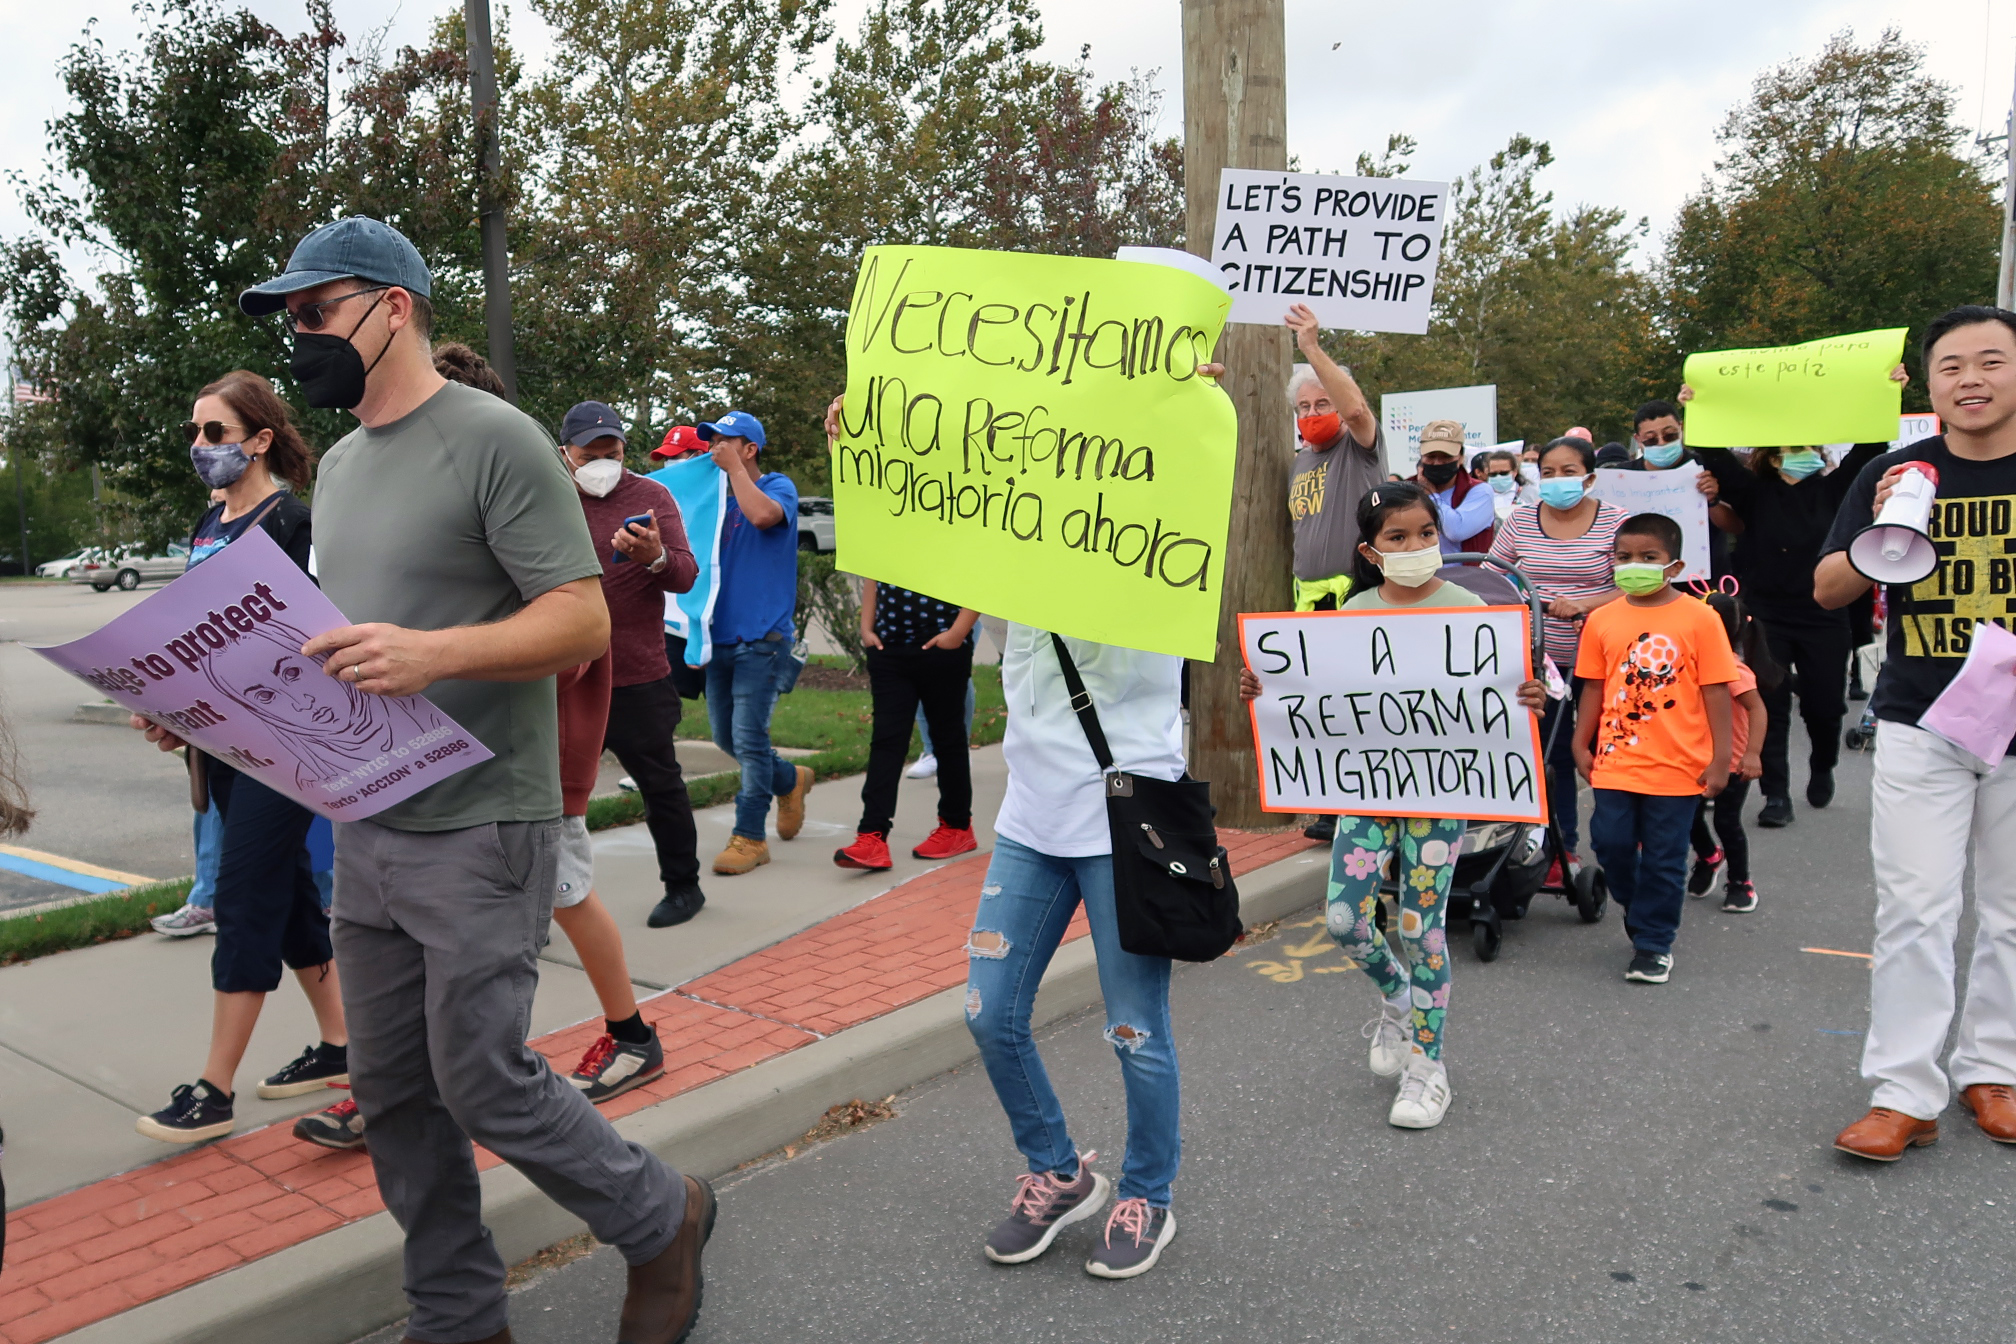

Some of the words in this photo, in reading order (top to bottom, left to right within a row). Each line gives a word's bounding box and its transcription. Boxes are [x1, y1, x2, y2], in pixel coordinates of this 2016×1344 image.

[1227, 177, 1301, 213] LET'S
[1314, 188, 1438, 222] PROVIDE
[1221, 222, 1247, 252] A
[1266, 224, 1347, 257] PATH
[1374, 231, 1431, 261] TO
[1220, 262, 1425, 302] CITIZENSHIP
[1719, 361, 1766, 379] este
[962, 397, 1154, 481] Reforma
[1904, 419, 1930, 435] TO
[839, 443, 1043, 541] migratoria
[1062, 492, 1211, 592] ahora
[1928, 500, 2011, 538] ROUD
[1938, 559, 1975, 595] TO
[1990, 558, 2016, 595] B
[130, 652, 176, 681] to
[165, 581, 288, 673] protect
[1257, 630, 1309, 677] SI
[1372, 626, 1396, 676] A
[1445, 623, 1498, 677] LA
[1279, 687, 1510, 740] REFORMA
[321, 775, 354, 794] Text
[391, 747, 410, 759] to
[407, 726, 453, 750] 52886
[322, 795, 358, 811] Texto
[414, 760, 426, 770] a
[424, 739, 470, 764] 52886
[1270, 746, 1534, 804] MIGRATORIA
